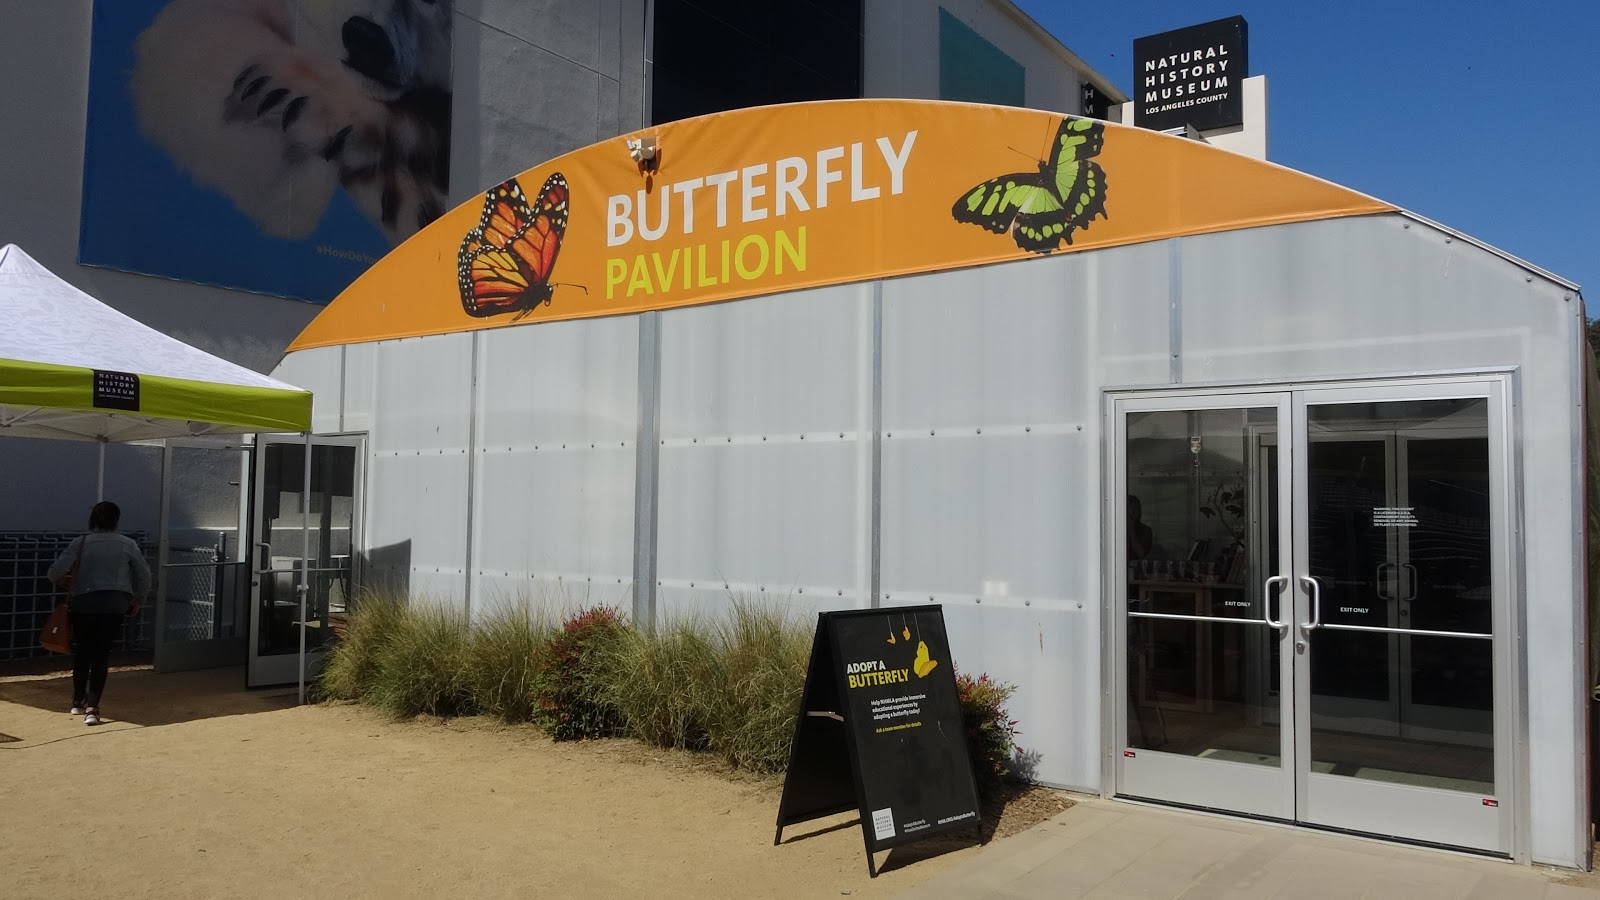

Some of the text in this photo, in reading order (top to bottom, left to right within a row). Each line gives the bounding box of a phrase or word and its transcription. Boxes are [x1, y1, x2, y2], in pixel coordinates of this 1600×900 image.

[1145, 44, 1228, 72] NATURAL
[1145, 59, 1228, 88] HISTORY
[1145, 76, 1228, 103] MUSEUM
[1145, 92, 1228, 115] LOS ANGELES COUNTY
[607, 130, 918, 247] BUTTERFLY
[606, 225, 807, 300] PAVILION
[99, 373, 135, 382] NATURAL
[99, 380, 135, 389] HISTORY
[99, 387, 135, 395] MUSEUM
[846, 660, 887, 675] ADOPT A
[848, 668, 909, 689] BUTTERFLY
